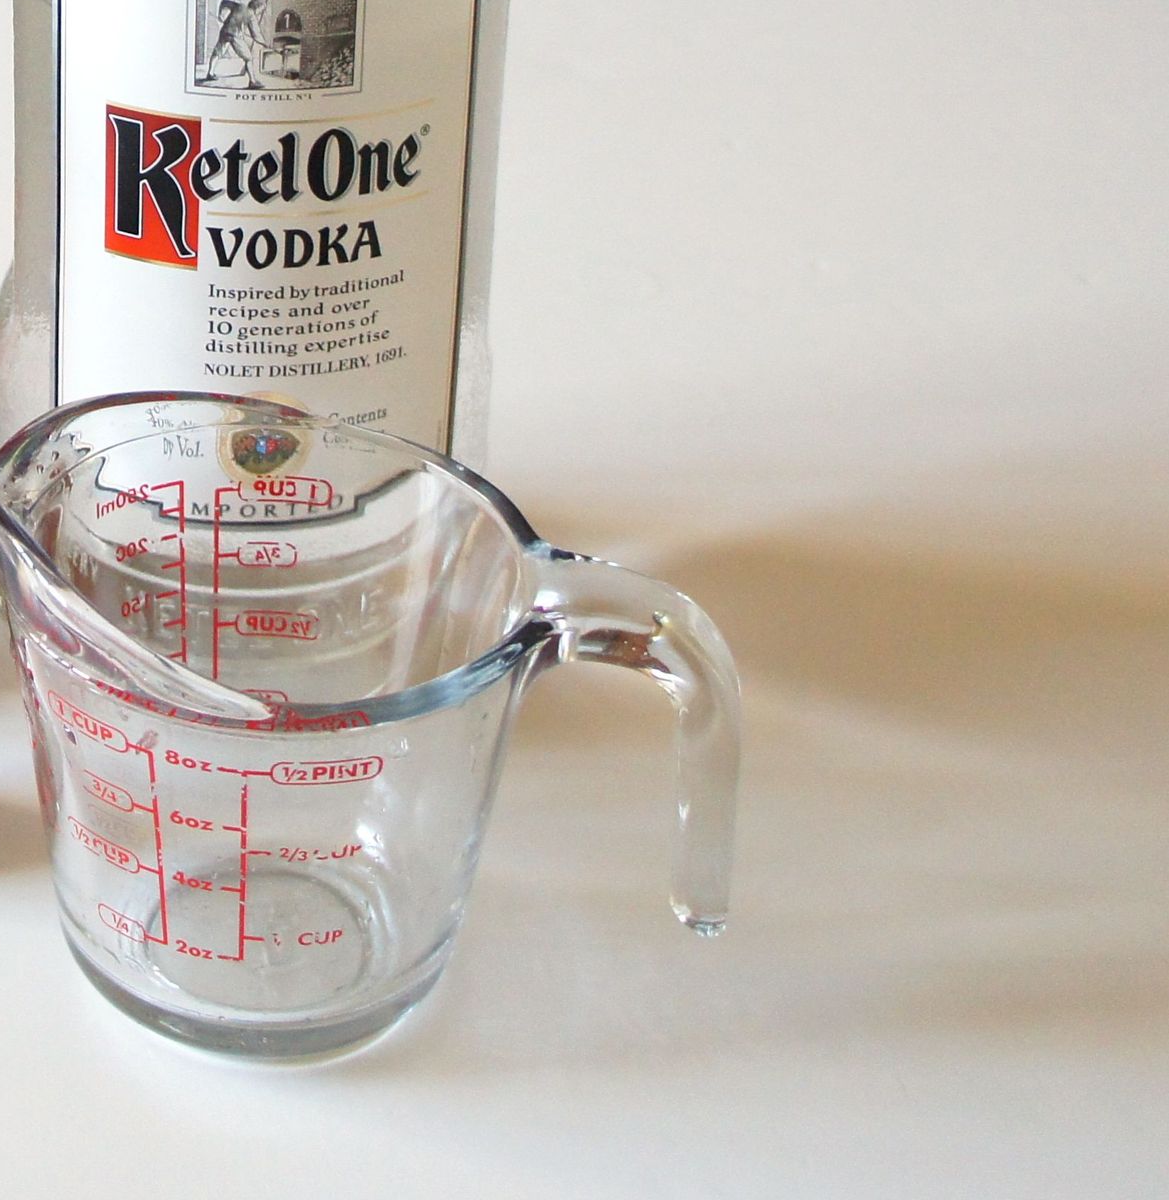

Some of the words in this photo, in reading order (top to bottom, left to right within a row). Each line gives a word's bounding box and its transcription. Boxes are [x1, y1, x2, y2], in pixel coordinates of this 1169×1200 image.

[206, 220, 382, 270] VODKA
[208, 284, 285, 302] Inspired
[290, 286, 311, 301] by
[314, 270, 405, 297] traditional
[208, 305, 280, 320] recipes
[288, 303, 323, 318] and
[331, 299, 370, 314] over
[237, 317, 356, 341] generations
[360, 311, 379, 326] of
[205, 340, 298, 357] distilling
[304, 329, 390, 353] expertise
[204, 363, 263, 377] NOLET
[269, 354, 371, 378] DISTILLERY,
[376, 347, 407, 364] 1691.
[176, 435, 205, 457] Vol.
[58, 700, 65, 715] 1
[73, 711, 113, 740] CUP
[282, 767, 308, 782] 1/2
[312, 762, 373, 780] PINT
[280, 847, 308, 862] 2/3
[112, 912, 129, 933] 1/4
[298, 930, 343, 946] CUP
